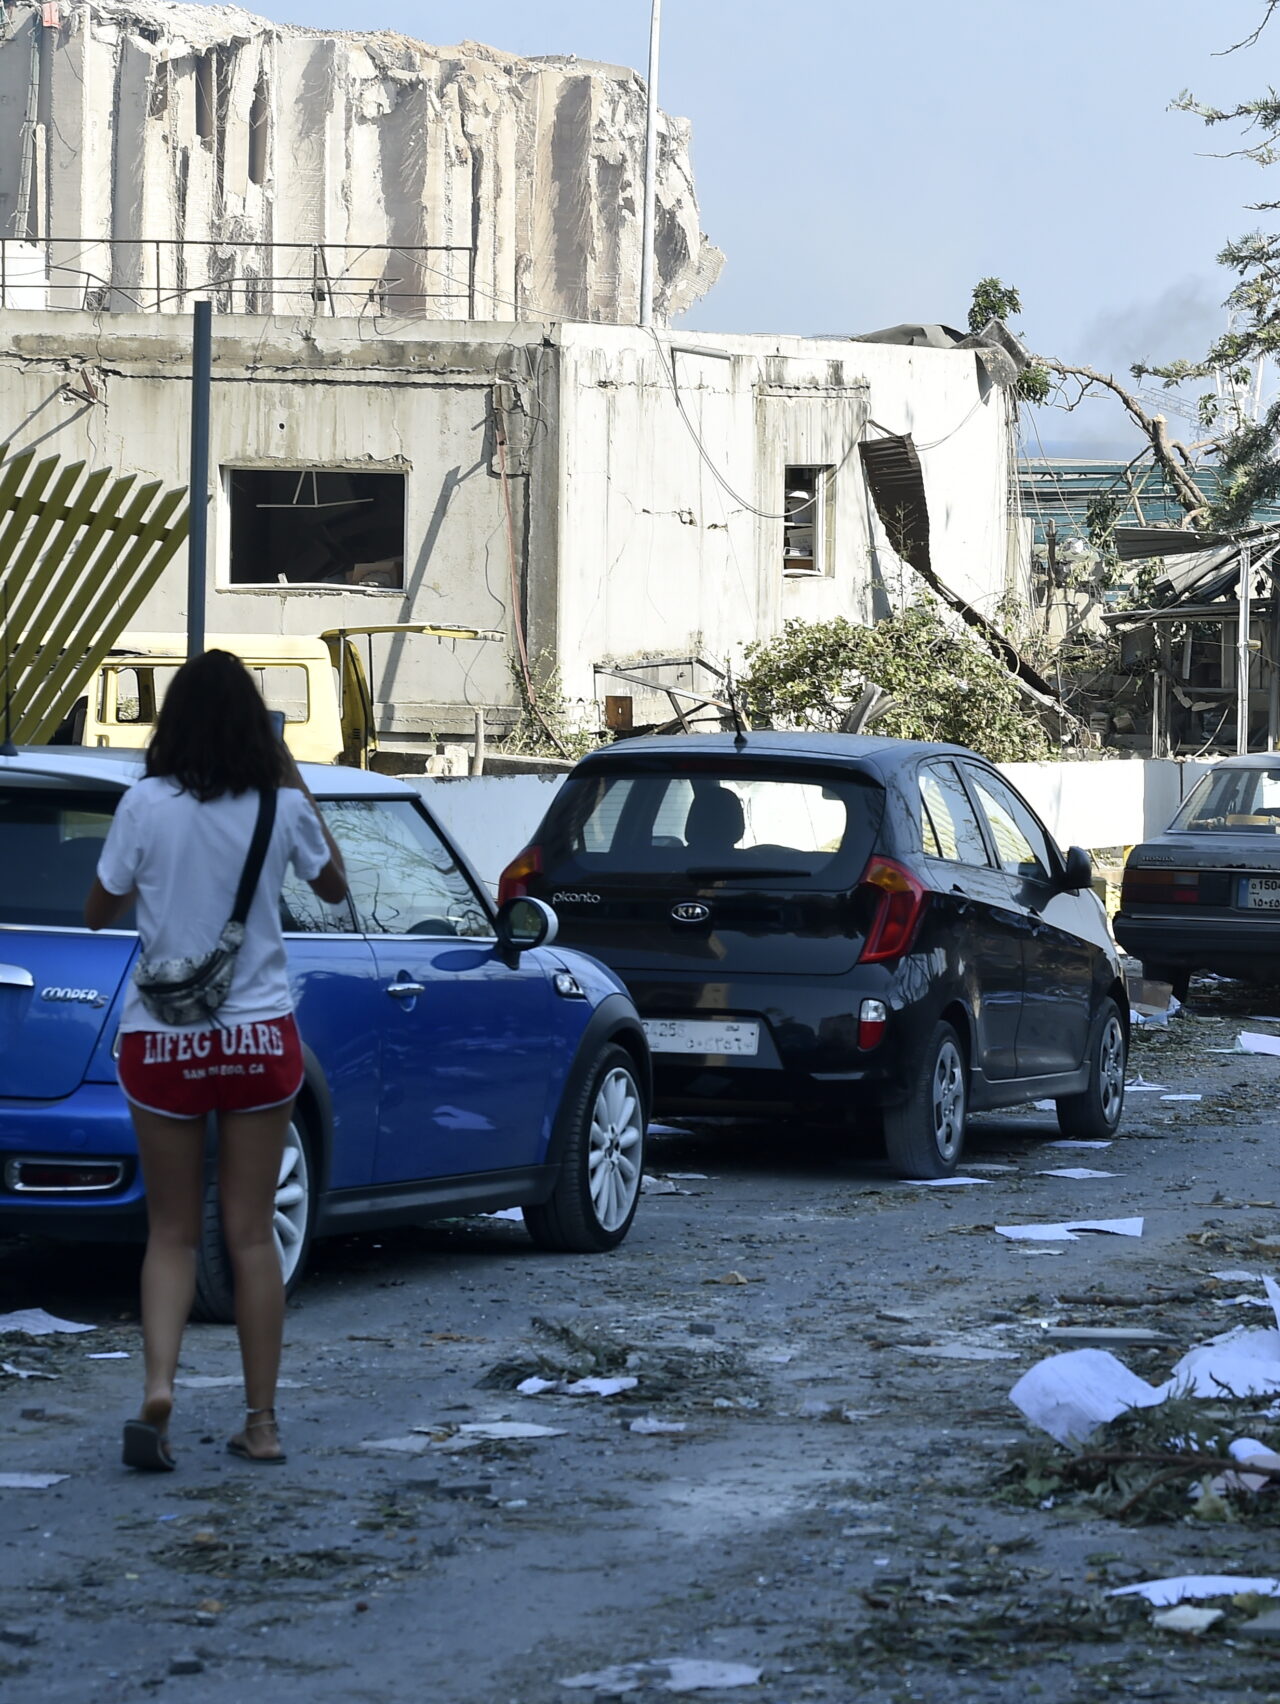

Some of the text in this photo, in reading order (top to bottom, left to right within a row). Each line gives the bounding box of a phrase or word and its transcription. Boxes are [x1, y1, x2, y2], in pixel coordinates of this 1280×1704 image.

[552, 891, 600, 904] picanto
[677, 906, 703, 918] KIA
[41, 986, 98, 1001] COOPER
[183, 1068, 206, 1080] SAN
[248, 1064, 265, 1074] CA
